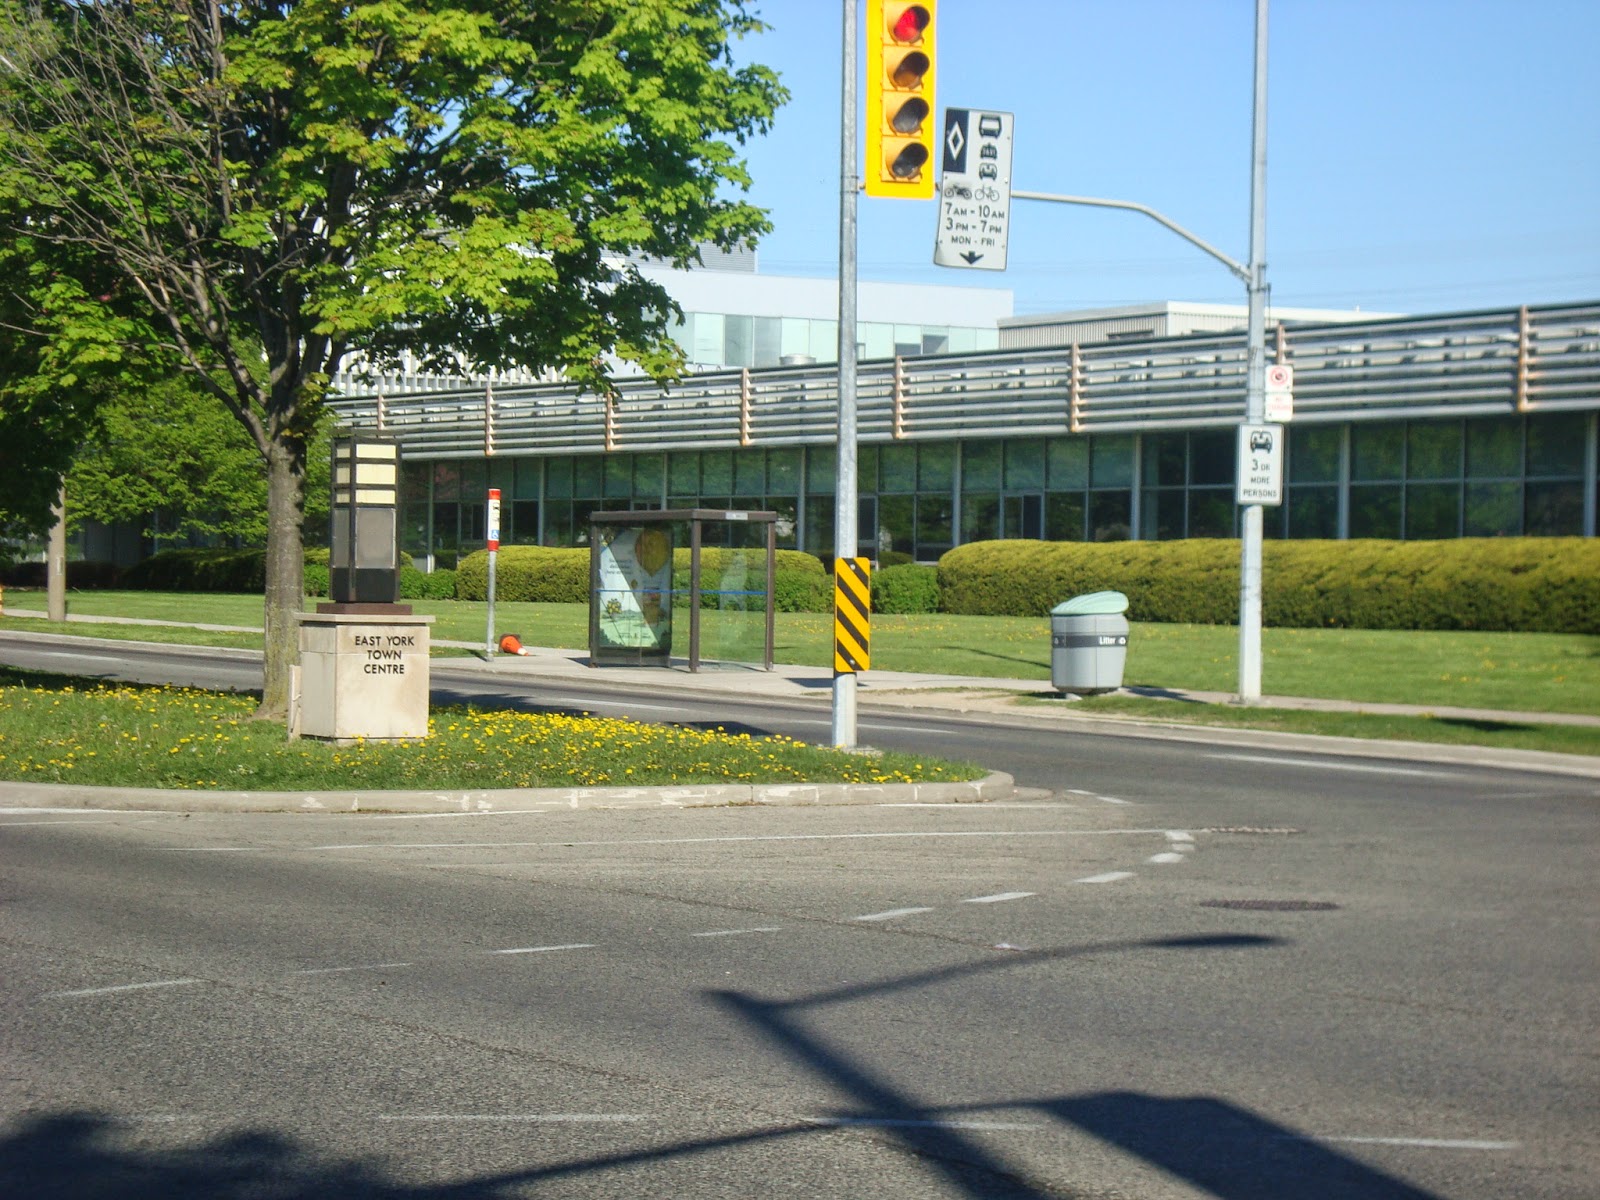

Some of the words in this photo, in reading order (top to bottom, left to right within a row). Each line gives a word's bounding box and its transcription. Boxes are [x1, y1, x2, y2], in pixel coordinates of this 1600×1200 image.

[951, 235, 971, 245] MON
[981, 237, 995, 247] FRI
[1251, 458, 1259, 472] 3
[1260, 463, 1271, 472] OR
[1250, 476, 1270, 485] MORE
[1243, 488, 1278, 498] PERSONS
[355, 635, 381, 647] EAST
[386, 635, 415, 647] YORK
[366, 649, 402, 660] TOWN
[363, 664, 405, 675] CENTRE
